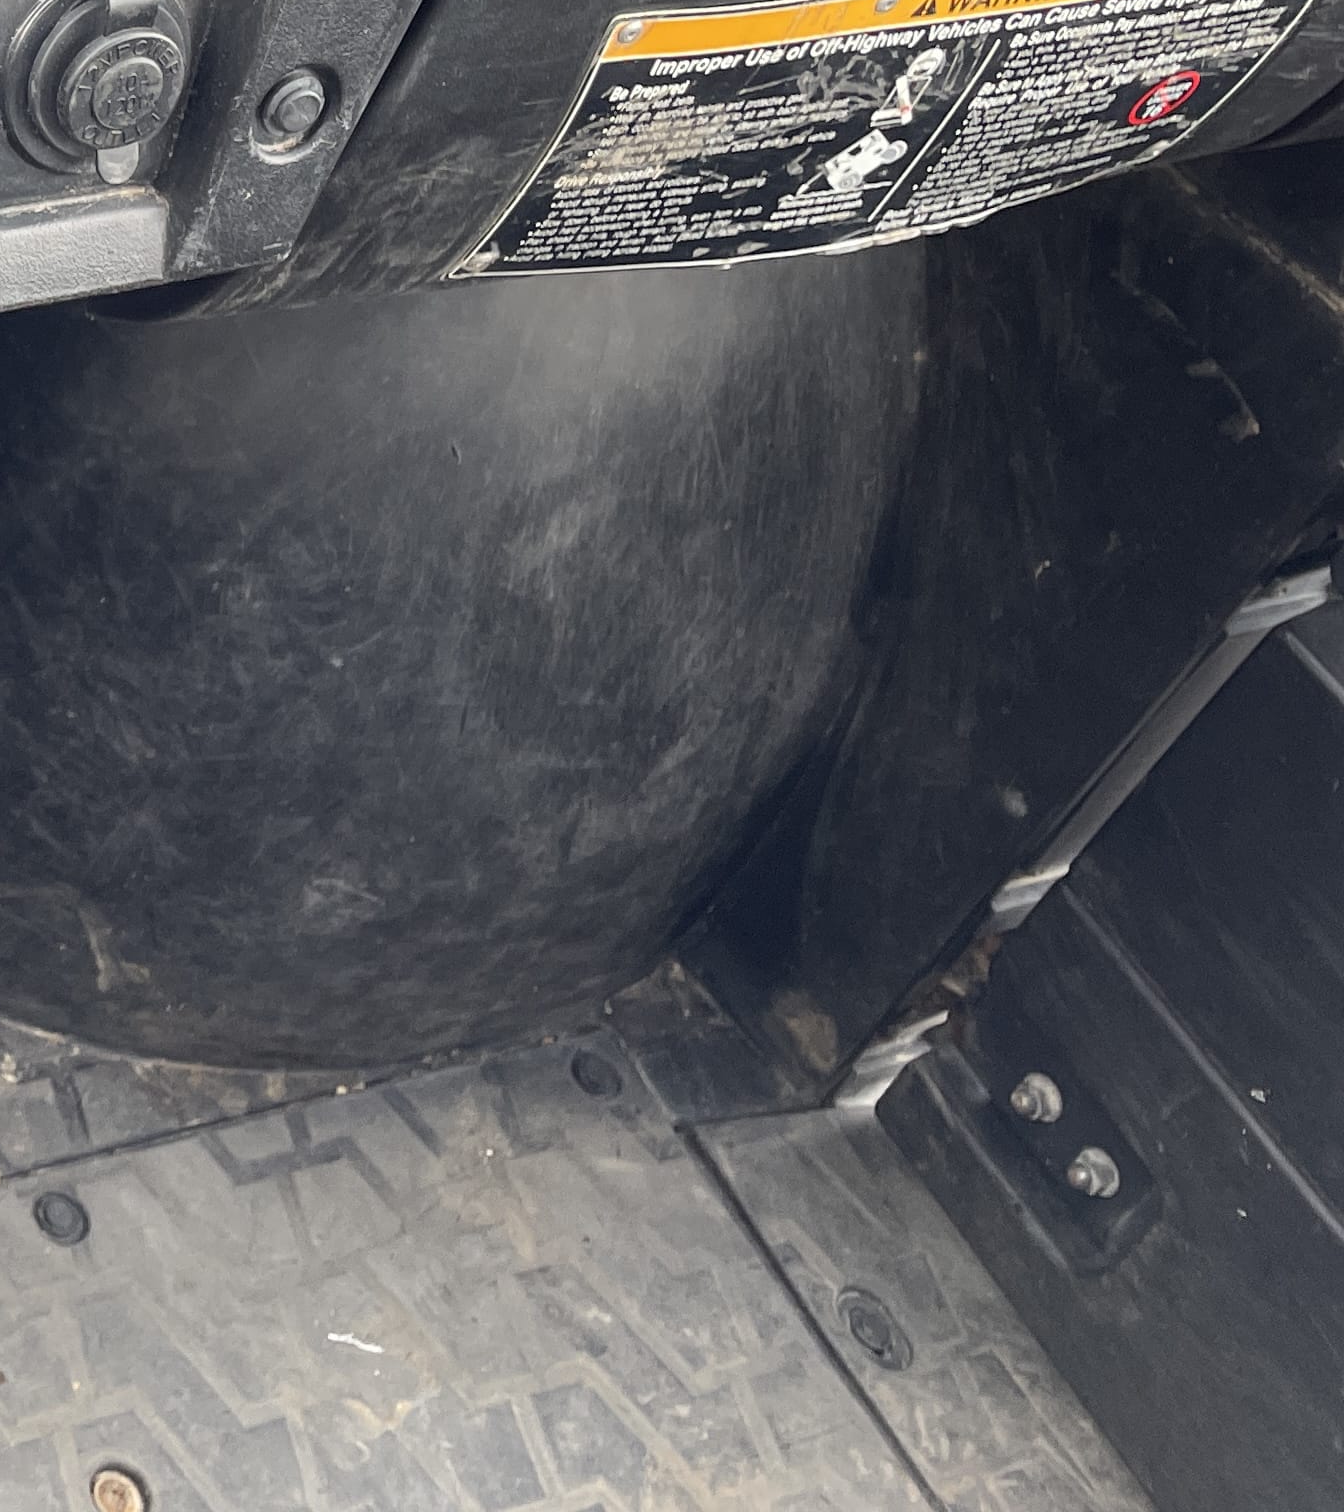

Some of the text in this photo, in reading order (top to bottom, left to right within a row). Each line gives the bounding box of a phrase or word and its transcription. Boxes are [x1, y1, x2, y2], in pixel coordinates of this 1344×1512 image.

[649, 53, 745, 78] Improper
[745, 48, 783, 67] Use
[786, 41, 811, 61] of
[810, 28, 927, 57] Off-Highway
[928, 16, 1003, 42] Vehicles
[1005, 12, 1043, 32] Can
[1045, 2, 1101, 24] Cause
[609, 79, 691, 102] Be Prepared
